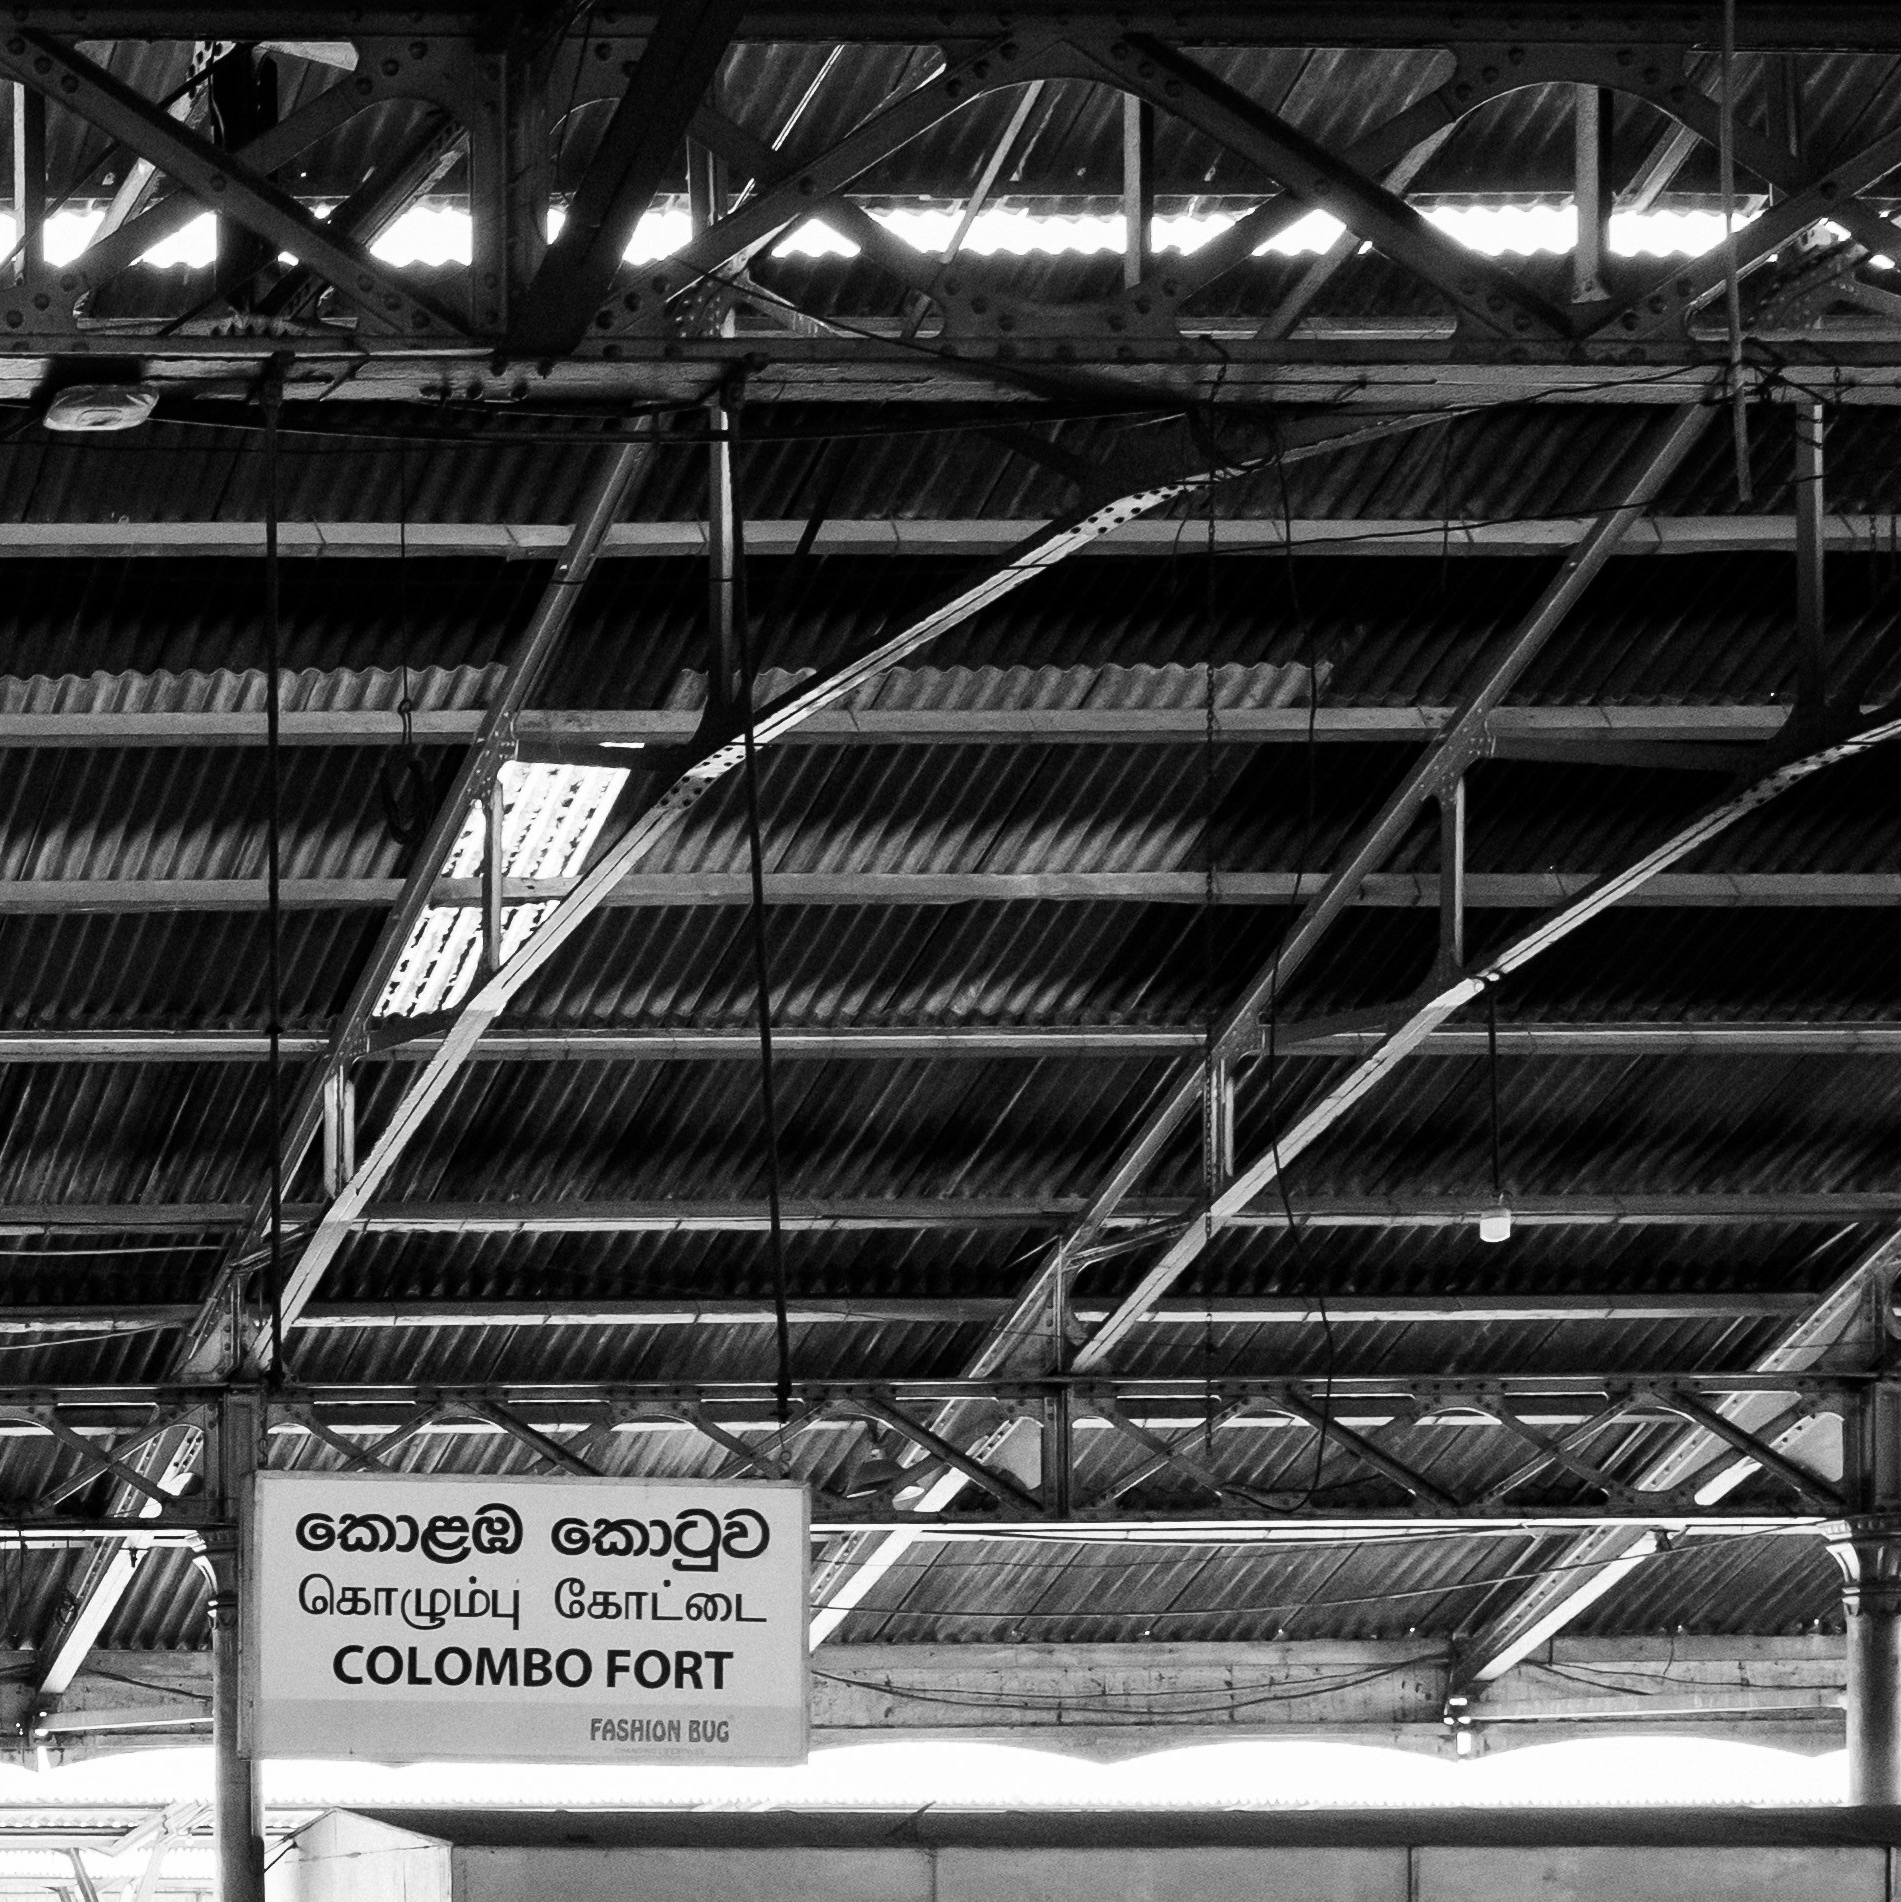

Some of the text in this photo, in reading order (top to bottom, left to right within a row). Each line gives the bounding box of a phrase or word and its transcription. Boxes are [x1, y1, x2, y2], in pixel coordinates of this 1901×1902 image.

[296, 1503, 770, 1572] කොළඹ කොටුව
[299, 1574, 768, 1630] கொழும்பு கோட்டை
[333, 1645, 734, 1690] COLOMBO FORT
[590, 1718, 729, 1743] FASHION BUG
